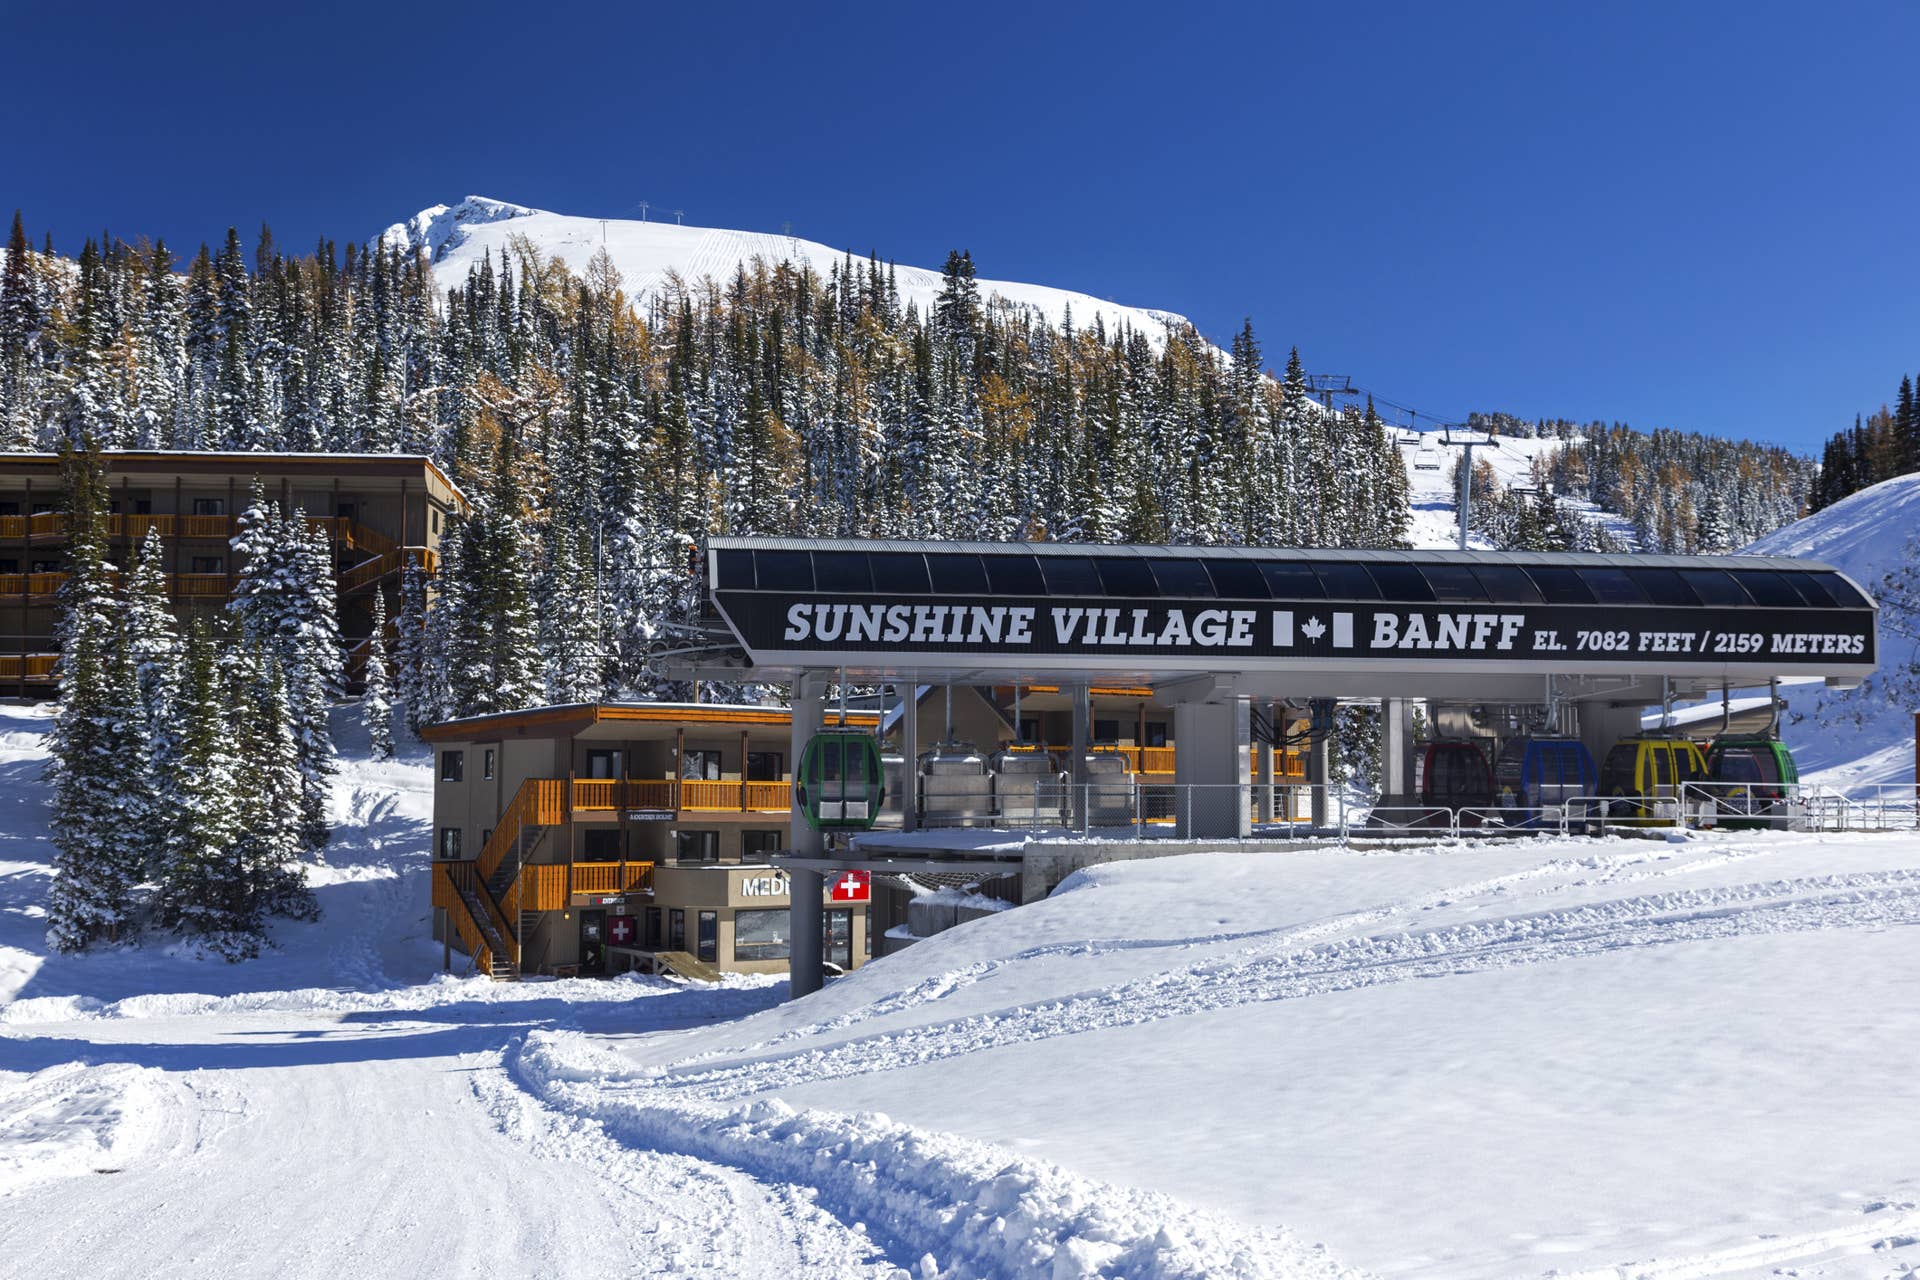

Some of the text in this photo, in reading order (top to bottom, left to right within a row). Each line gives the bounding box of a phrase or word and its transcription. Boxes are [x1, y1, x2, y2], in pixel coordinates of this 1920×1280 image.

[784, 603, 1036, 645] SUNSHINE
[1051, 606, 1256, 648] VILLAGE
[1369, 612, 1525, 652] BANFF
[1533, 630, 1568, 652] EL.
[1576, 630, 1630, 652] 7082
[1770, 633, 1866, 656] METERS
